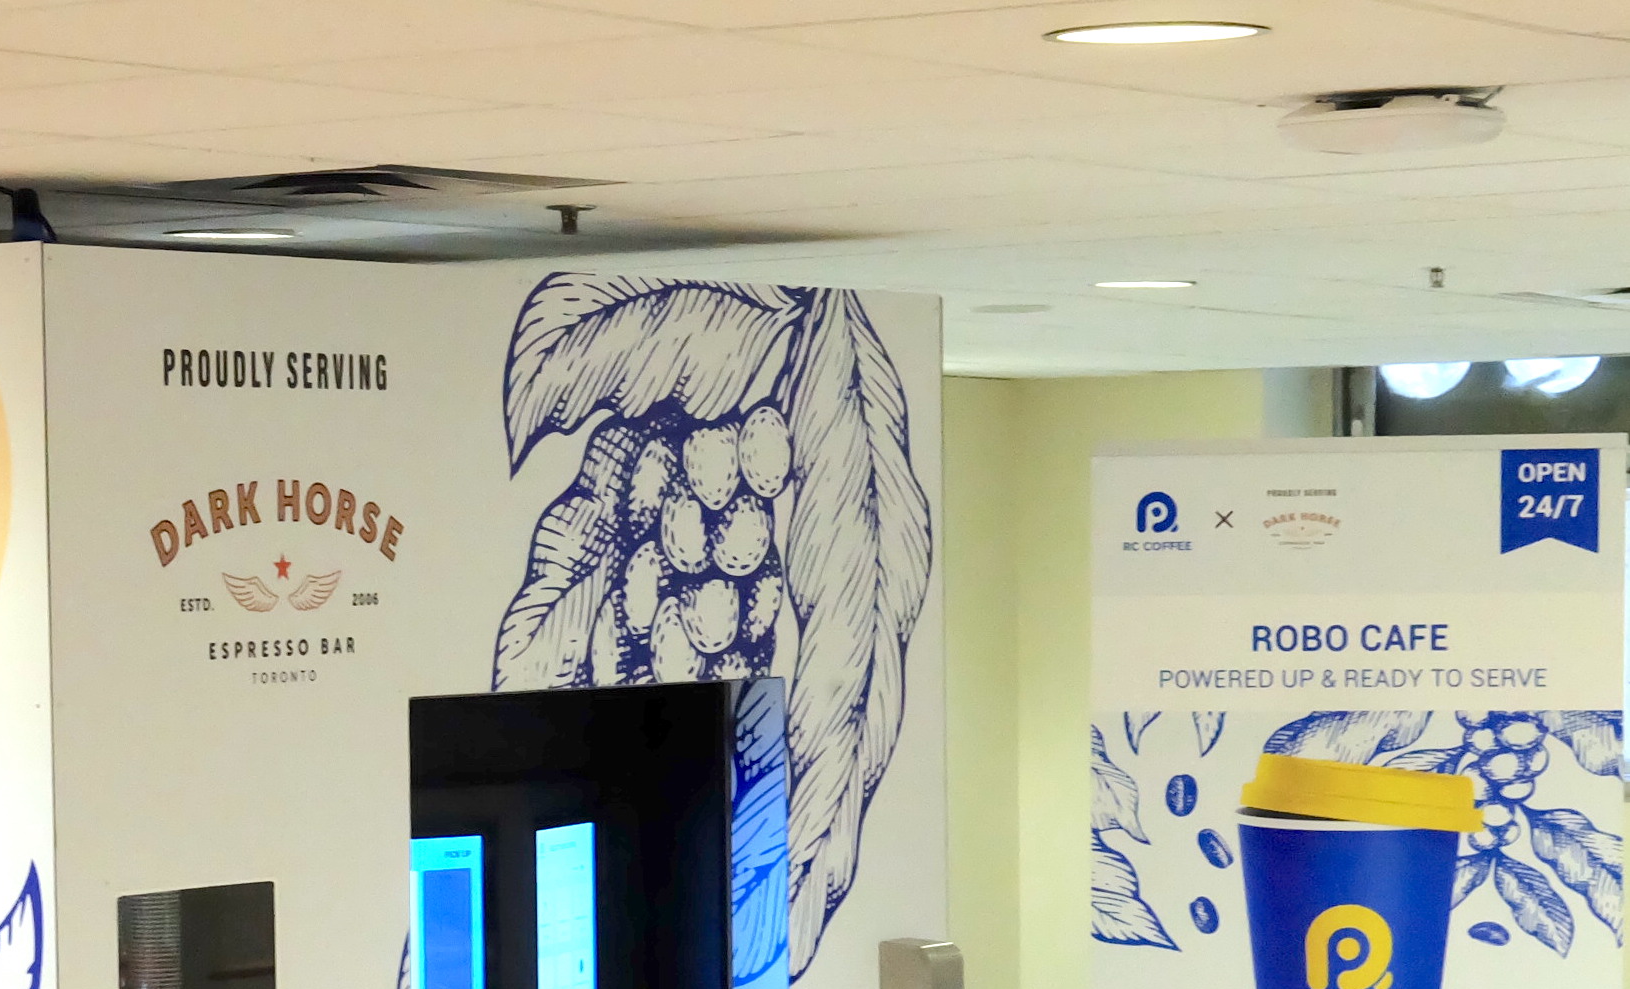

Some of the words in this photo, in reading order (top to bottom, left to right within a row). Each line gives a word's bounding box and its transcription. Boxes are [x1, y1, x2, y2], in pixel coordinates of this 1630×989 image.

[163, 348, 274, 388] PROUDLY
[286, 351, 388, 391] SERVING
[1518, 462, 1586, 484] OPEN
[1518, 495, 1584, 519] 24/7
[150, 481, 261, 568] DARK
[277, 479, 404, 561] HORSE
[180, 598, 214, 612] ESTD.
[209, 639, 310, 660] ESPRESSO
[321, 637, 356, 655] BAR
[1252, 625, 1349, 652] ROBO
[1360, 624, 1449, 651] CAFE
[252, 670, 317, 685] TORONTO
[1159, 669, 1275, 689] POWERED
[1282, 669, 1314, 688] UP
[1321, 669, 1337, 688] &
[1344, 669, 1421, 689] READY
[1432, 668, 1462, 688] TO
[1470, 668, 1547, 688] SERVE
